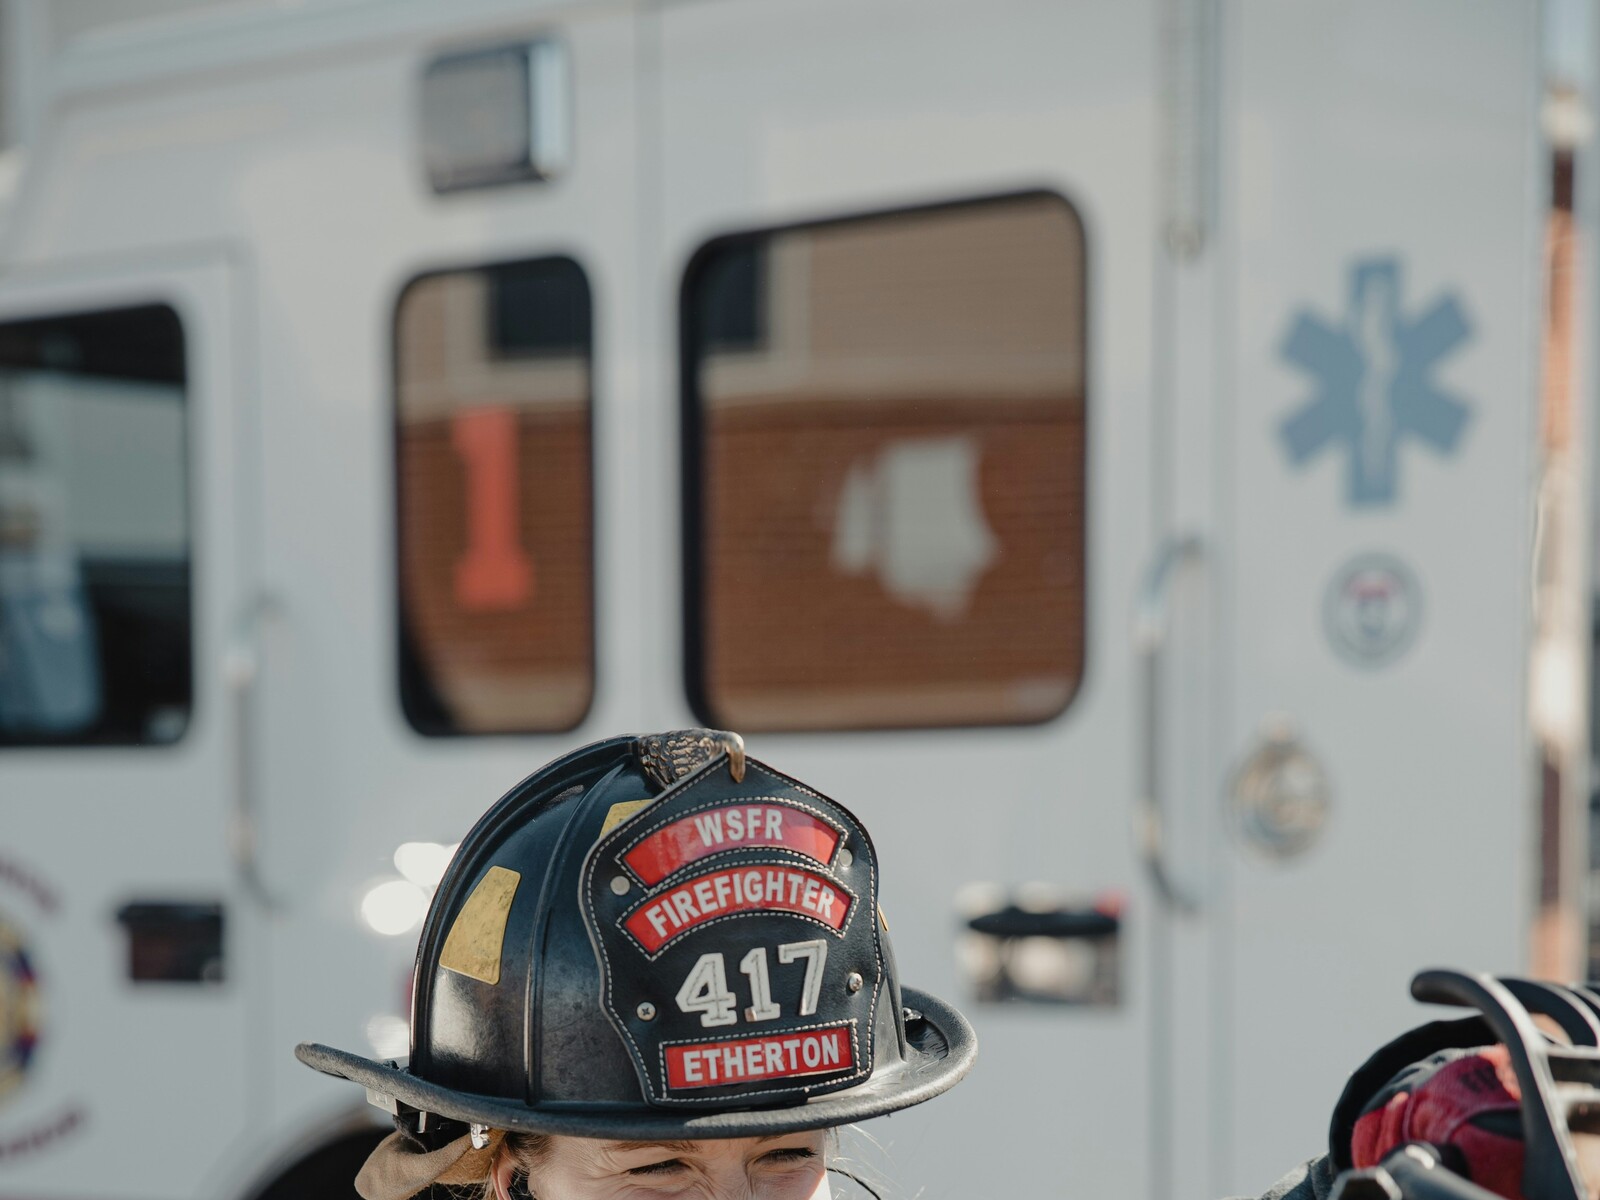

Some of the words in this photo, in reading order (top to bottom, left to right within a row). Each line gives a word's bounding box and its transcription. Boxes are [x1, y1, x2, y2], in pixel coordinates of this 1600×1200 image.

[695, 808, 783, 847] WSFR
[645, 870, 836, 938] FIREFIGHTER
[674, 939, 828, 1028] 417
[682, 1034, 840, 1083] ETHERTON
